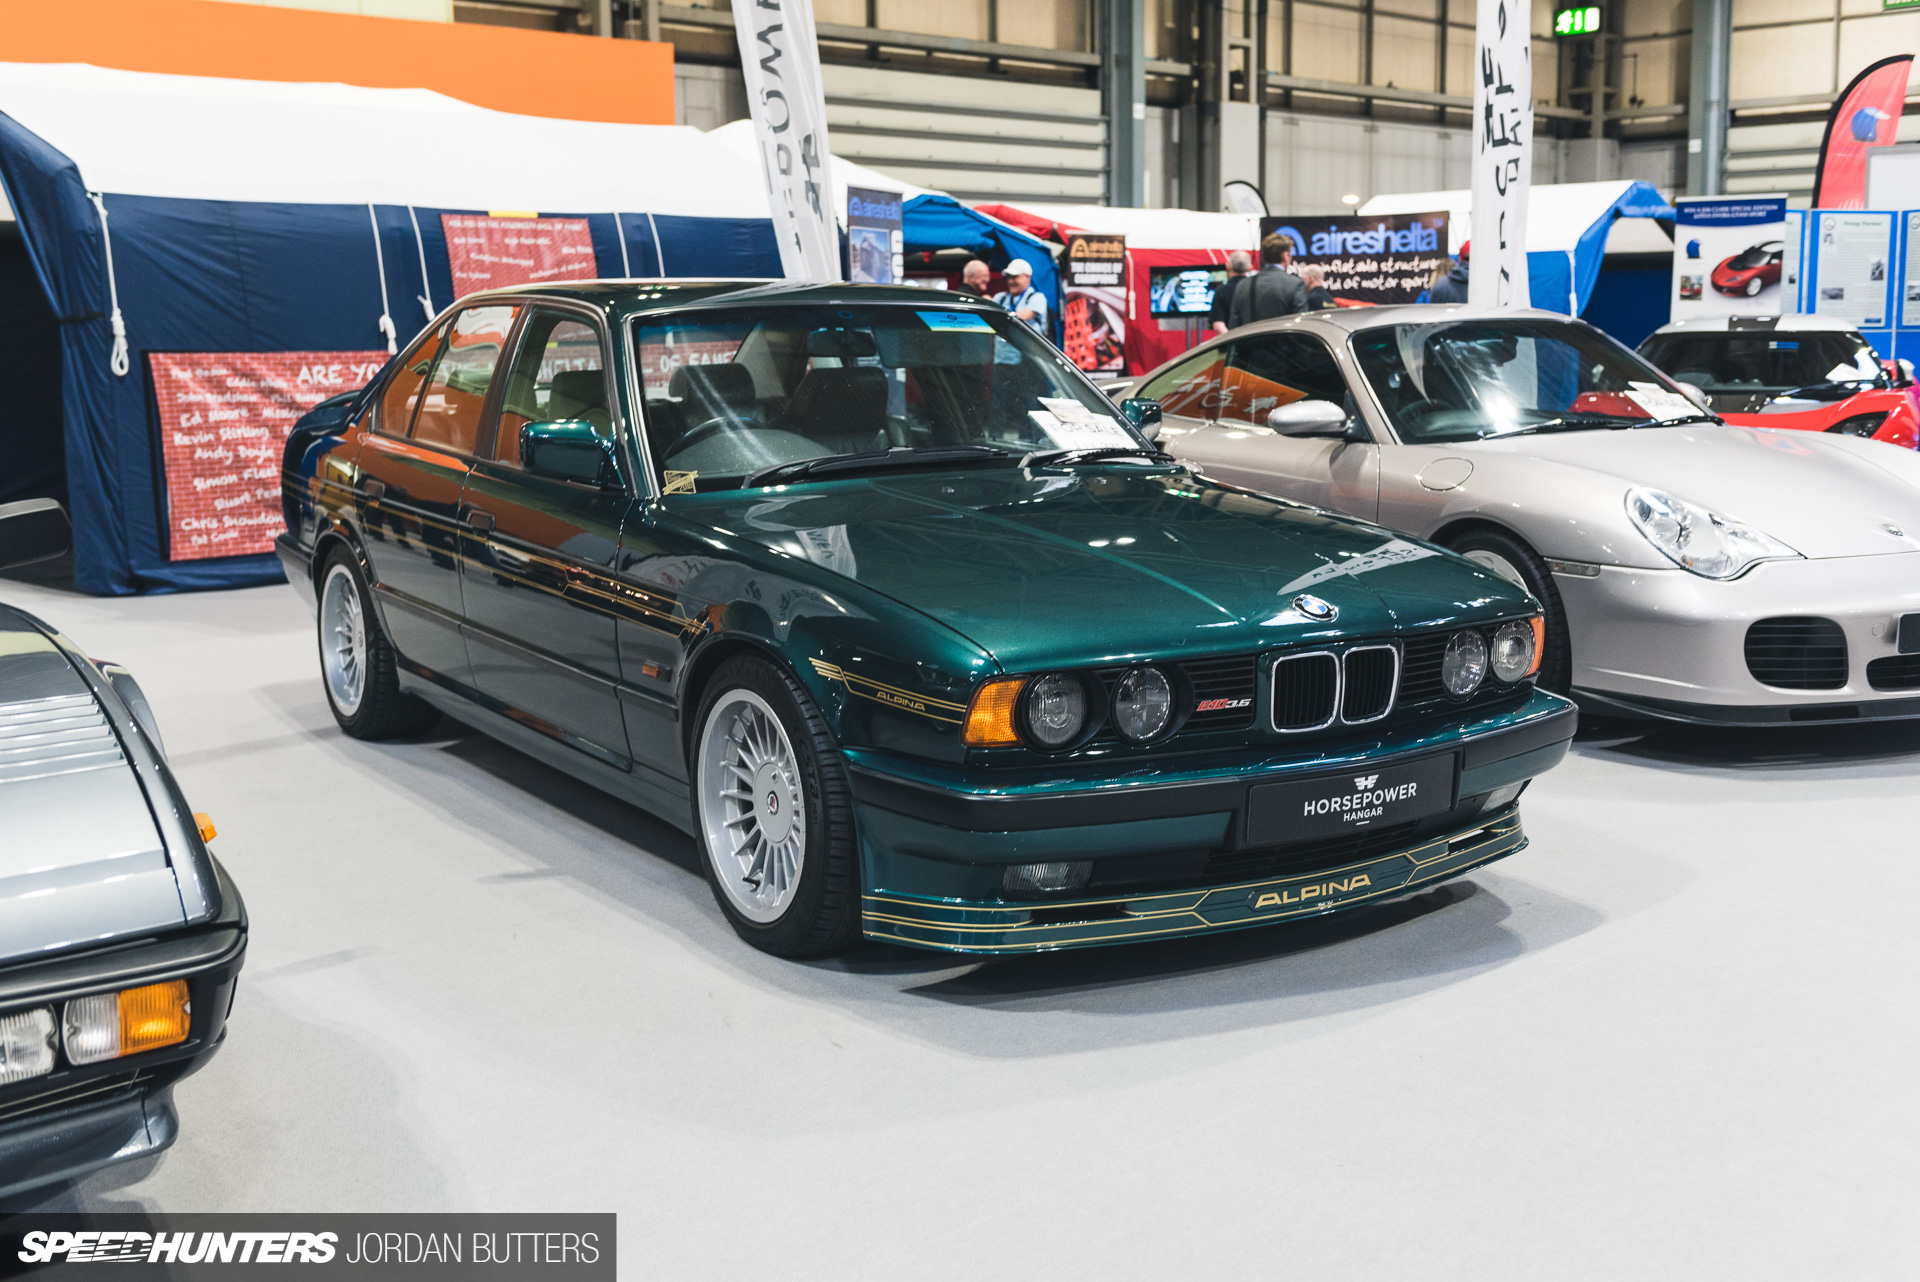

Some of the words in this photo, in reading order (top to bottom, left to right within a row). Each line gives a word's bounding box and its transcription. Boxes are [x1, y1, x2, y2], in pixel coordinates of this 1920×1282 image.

[1311, 221, 1438, 256] aireshelta
[297, 364, 344, 386] ARE
[350, 363, 386, 384] YO
[180, 410, 202, 427] Ed
[208, 408, 249, 425] Moore
[173, 432, 214, 446] Kevin
[219, 426, 270, 442] Stirling
[1085, 424, 1124, 436] SALE
[194, 448, 234, 465] Andy
[238, 446, 275, 464] Doyle
[193, 474, 238, 491] Simon
[243, 465, 279, 481] Fleet
[214, 493, 252, 510] Stuart
[181, 516, 218, 531] Chris
[223, 512, 284, 528] Snowdon
[876, 691, 926, 711] ALPINA
[1303, 783, 1418, 817] HORSEPOWER
[1343, 806, 1384, 822] HANGAR
[1255, 874, 1372, 909] ALPINA
